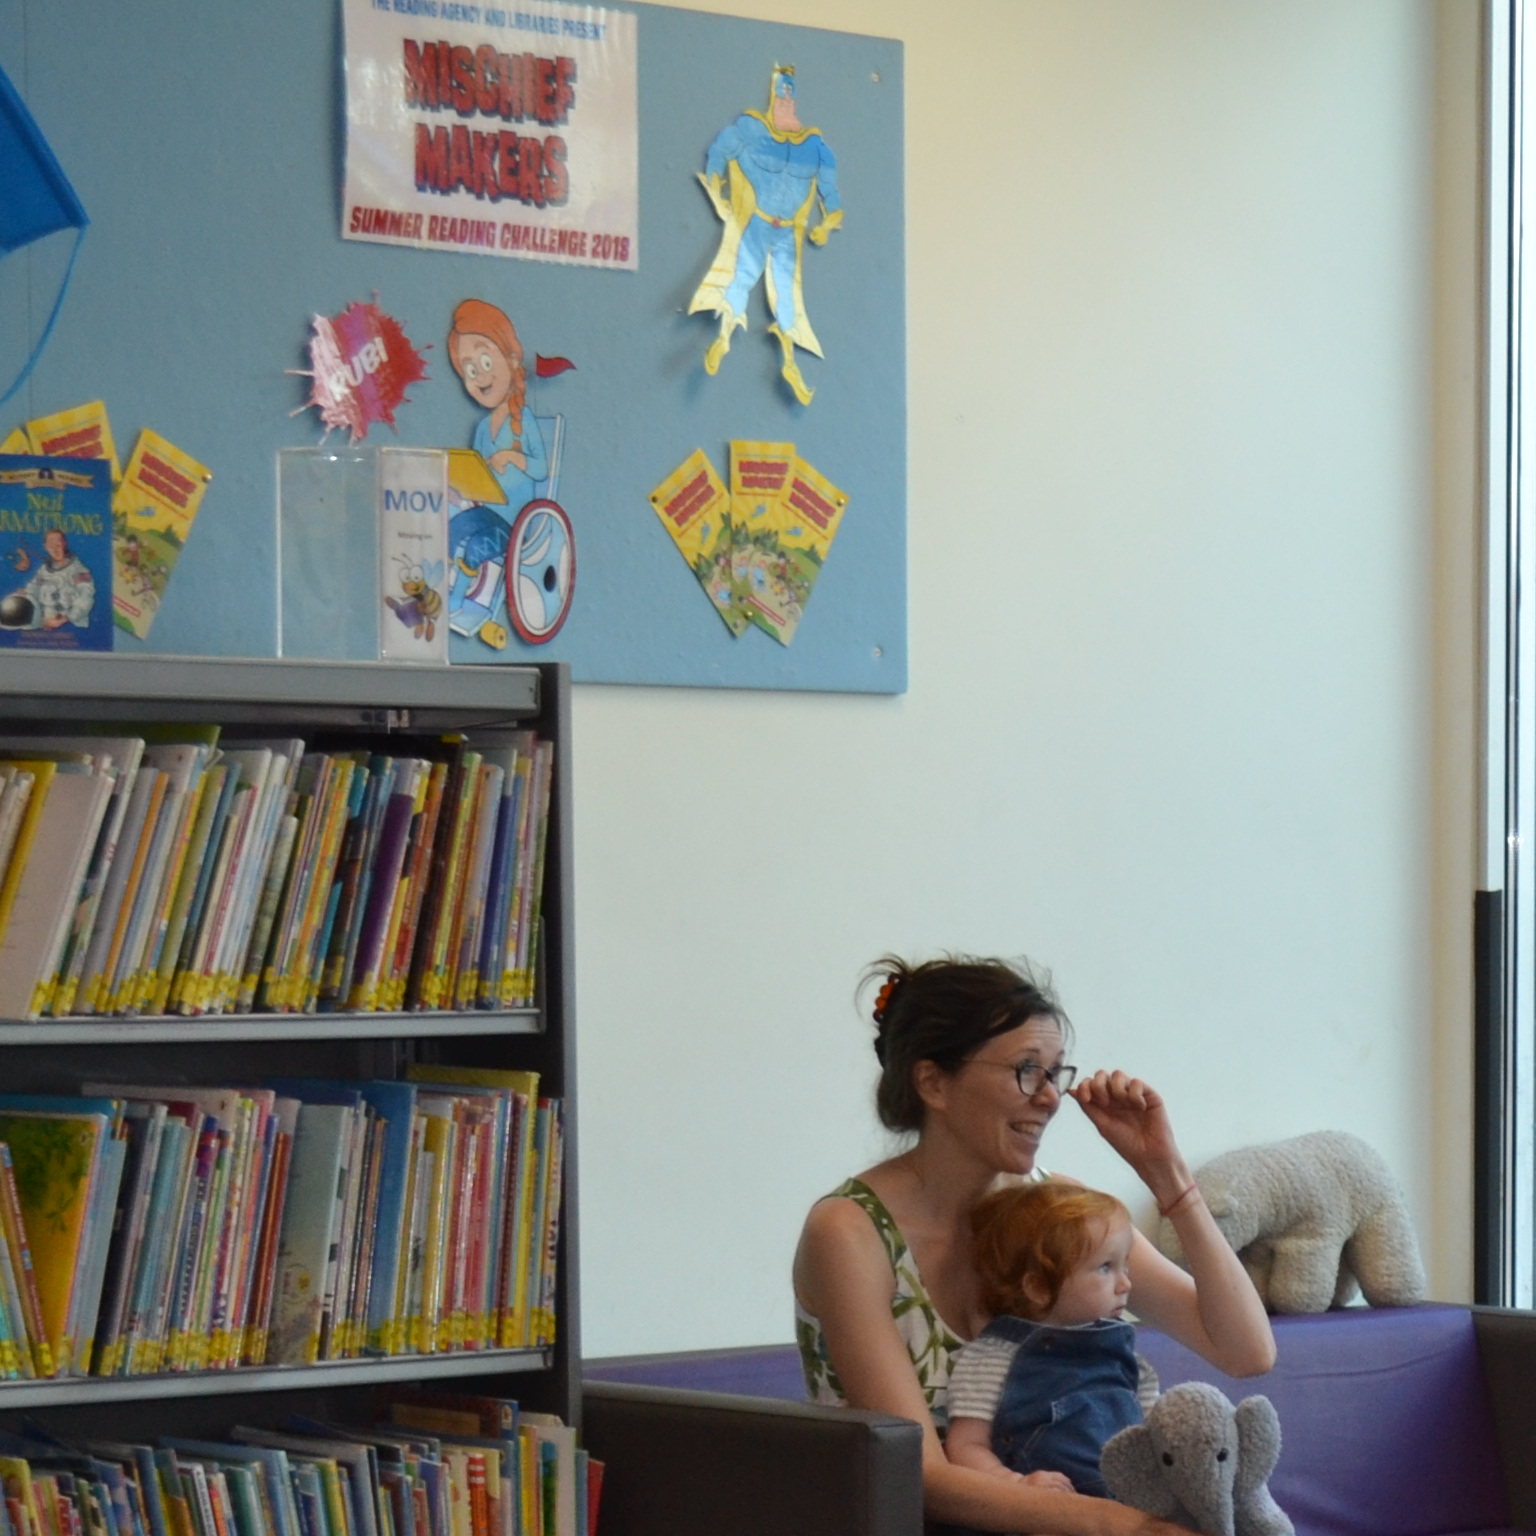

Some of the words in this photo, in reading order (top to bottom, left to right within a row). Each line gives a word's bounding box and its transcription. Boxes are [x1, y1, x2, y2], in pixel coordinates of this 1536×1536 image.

[441, 3, 481, 24] AGENCY
[485, 9, 507, 27] AND
[510, 12, 559, 35] LIBRARIES
[562, 19, 607, 41] PRESENT
[403, 39, 577, 127] MISCHIEF
[415, 122, 570, 209] MAKERS
[350, 206, 423, 240] SUMMER
[428, 215, 497, 249] READING
[500, 223, 588, 258] CHALLENGE
[591, 234, 630, 262] 2018
[385, 489, 444, 514] MOV
